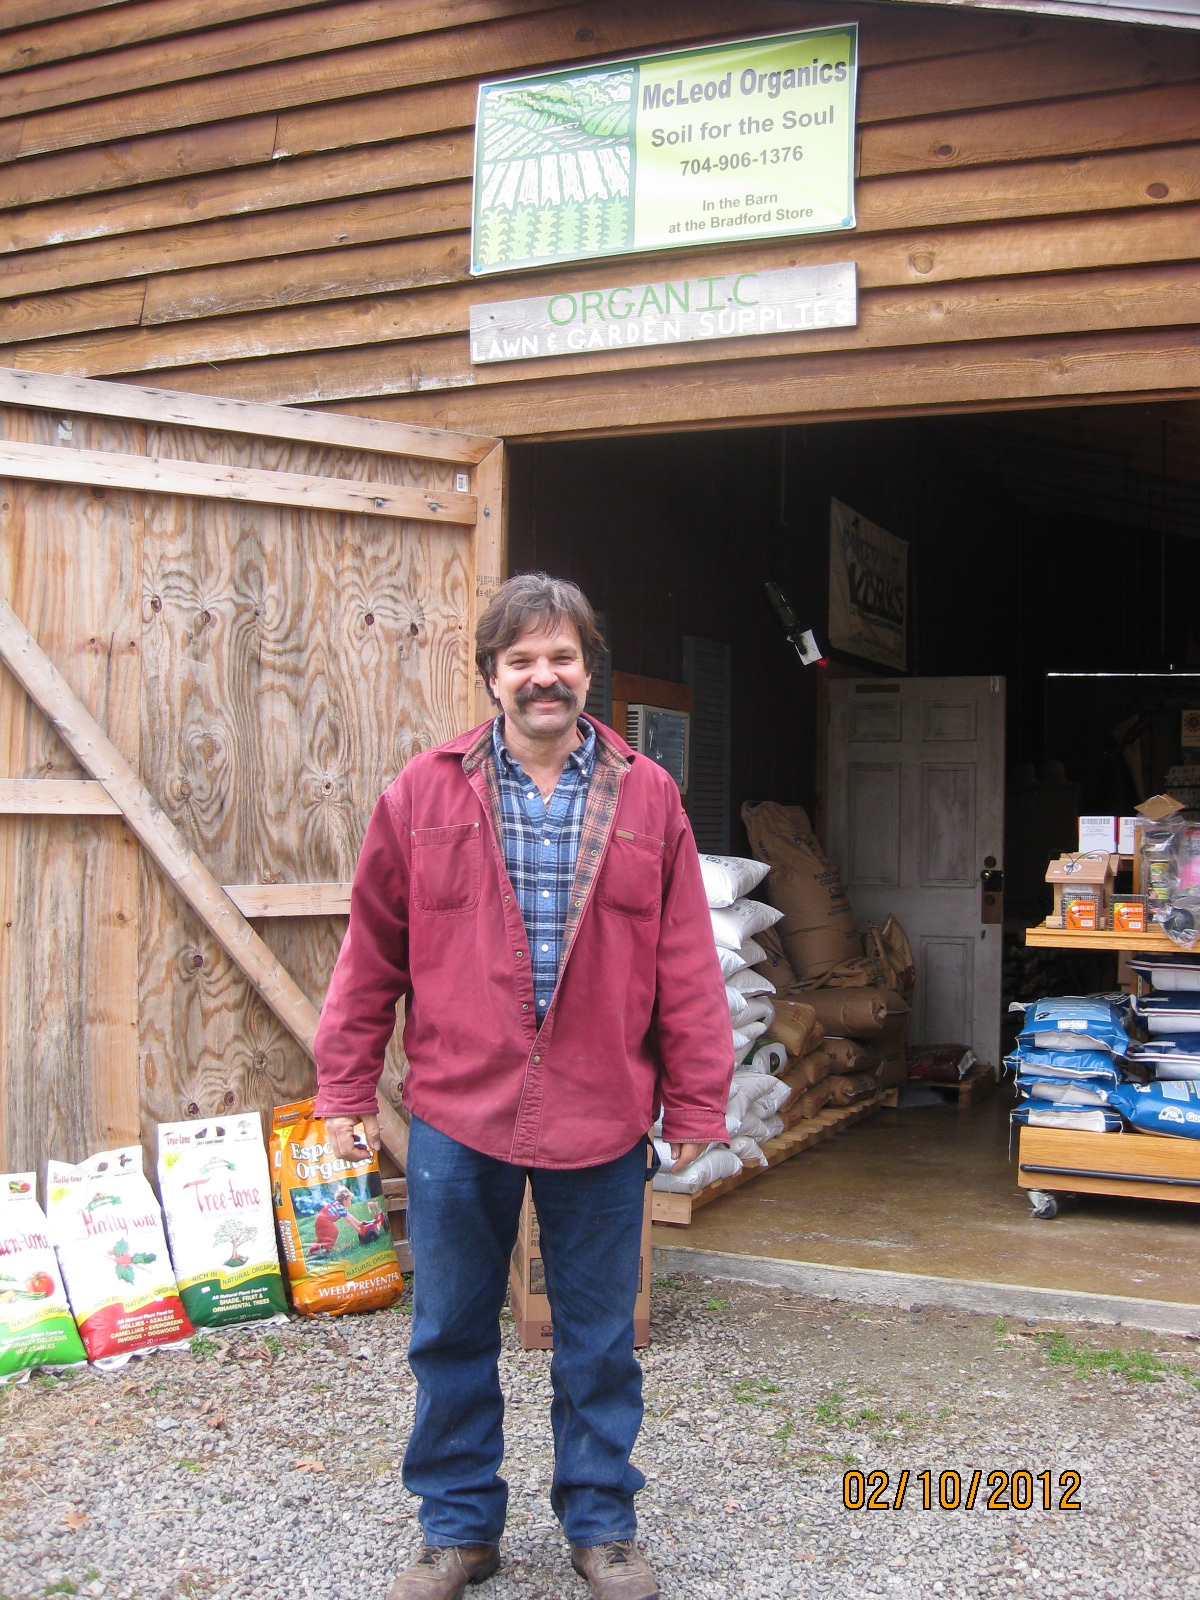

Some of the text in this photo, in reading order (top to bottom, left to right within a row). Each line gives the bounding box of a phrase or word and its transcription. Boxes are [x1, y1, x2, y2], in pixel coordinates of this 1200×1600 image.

[642, 57, 848, 111] McLeod Organics
[651, 105, 835, 148] Soil for the Soul
[680, 145, 804, 177] 704-906-1376
[702, 191, 778, 212] In the Barn
[668, 205, 814, 234] at the Bradford Store
[547, 273, 760, 327] ORGANIC
[472, 334, 538, 362] LAWN
[567, 317, 681, 350] GARDEN
[699, 299, 852, 338] SUPPLIES
[163, 1131, 191, 1146] Tree-tone
[183, 1177, 260, 1213] Tree-tone
[346, 1261, 372, 1276] NATURAL
[192, 1273, 209, 1283] RICH
[222, 1271, 251, 1285] NATURAL
[318, 1272, 400, 1297] WEED PREVENTER
[242, 1293, 258, 1302] FRUIT
[356, 1289, 373, 1297] LAWN
[375, 1284, 392, 1292] FOOD
[125, 1293, 153, 1308] NATURAL
[212, 1298, 270, 1313] ORNAMENTAL TREES
[110, 1318, 184, 1339] CAMELLIAS EVERGREENS
[120, 1314, 175, 1330] HOLLIES AZALEAS
[38, 1335, 68, 1344] DELICIOUS
[117, 1326, 180, 1343] RHODOS DOGWOODS
[16, 1343, 56, 1355] VEGETABLES
